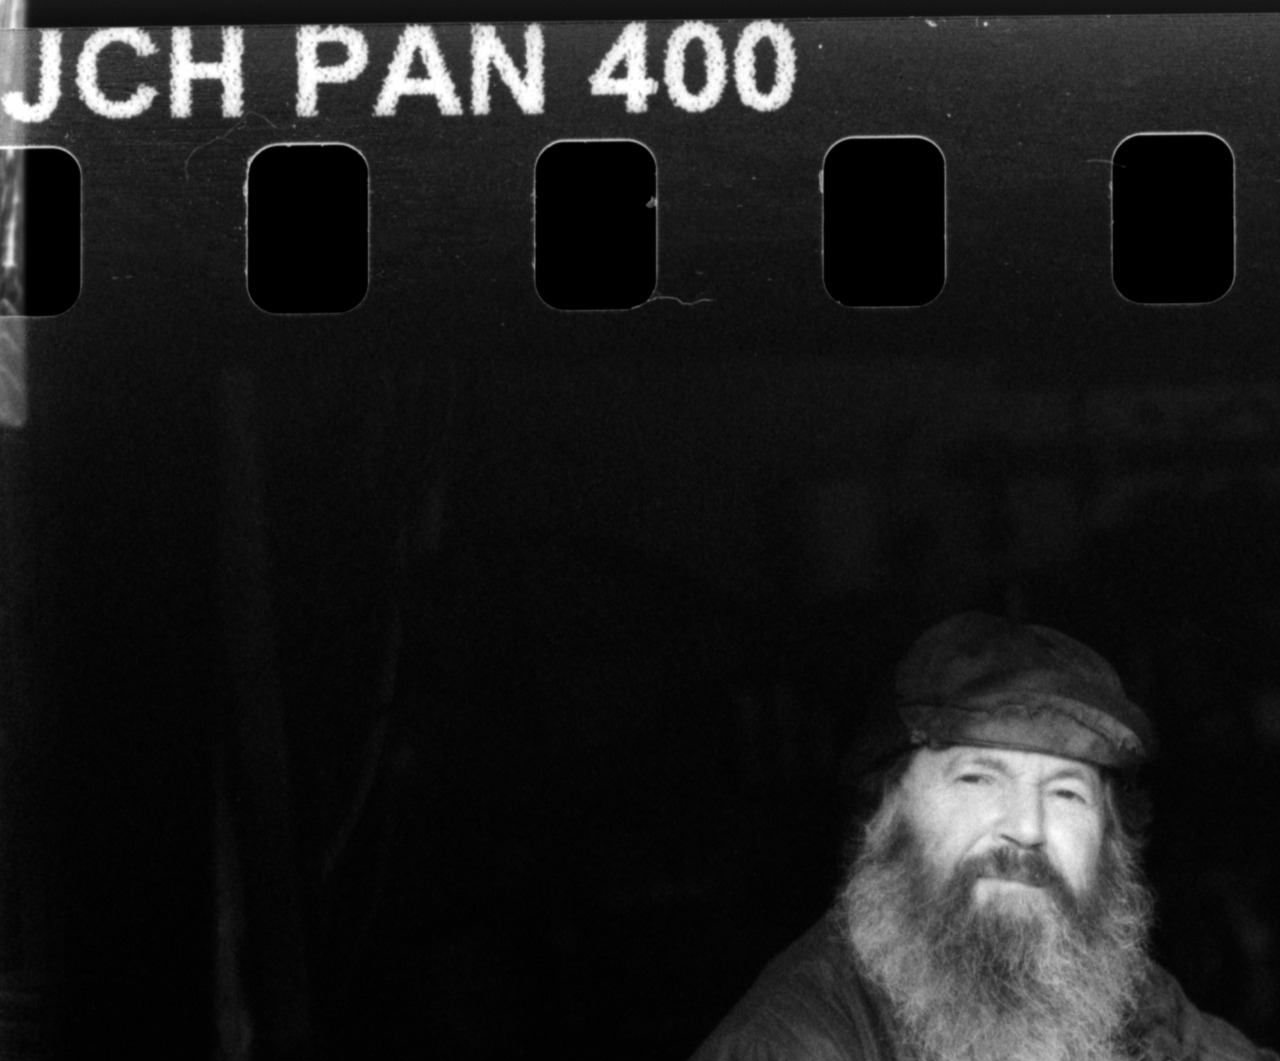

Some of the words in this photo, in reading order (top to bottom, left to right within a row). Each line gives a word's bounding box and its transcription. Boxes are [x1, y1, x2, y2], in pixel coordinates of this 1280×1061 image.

[1, 26, 245, 123] JCH
[295, 23, 546, 118] PAN
[588, 20, 798, 114] 400
